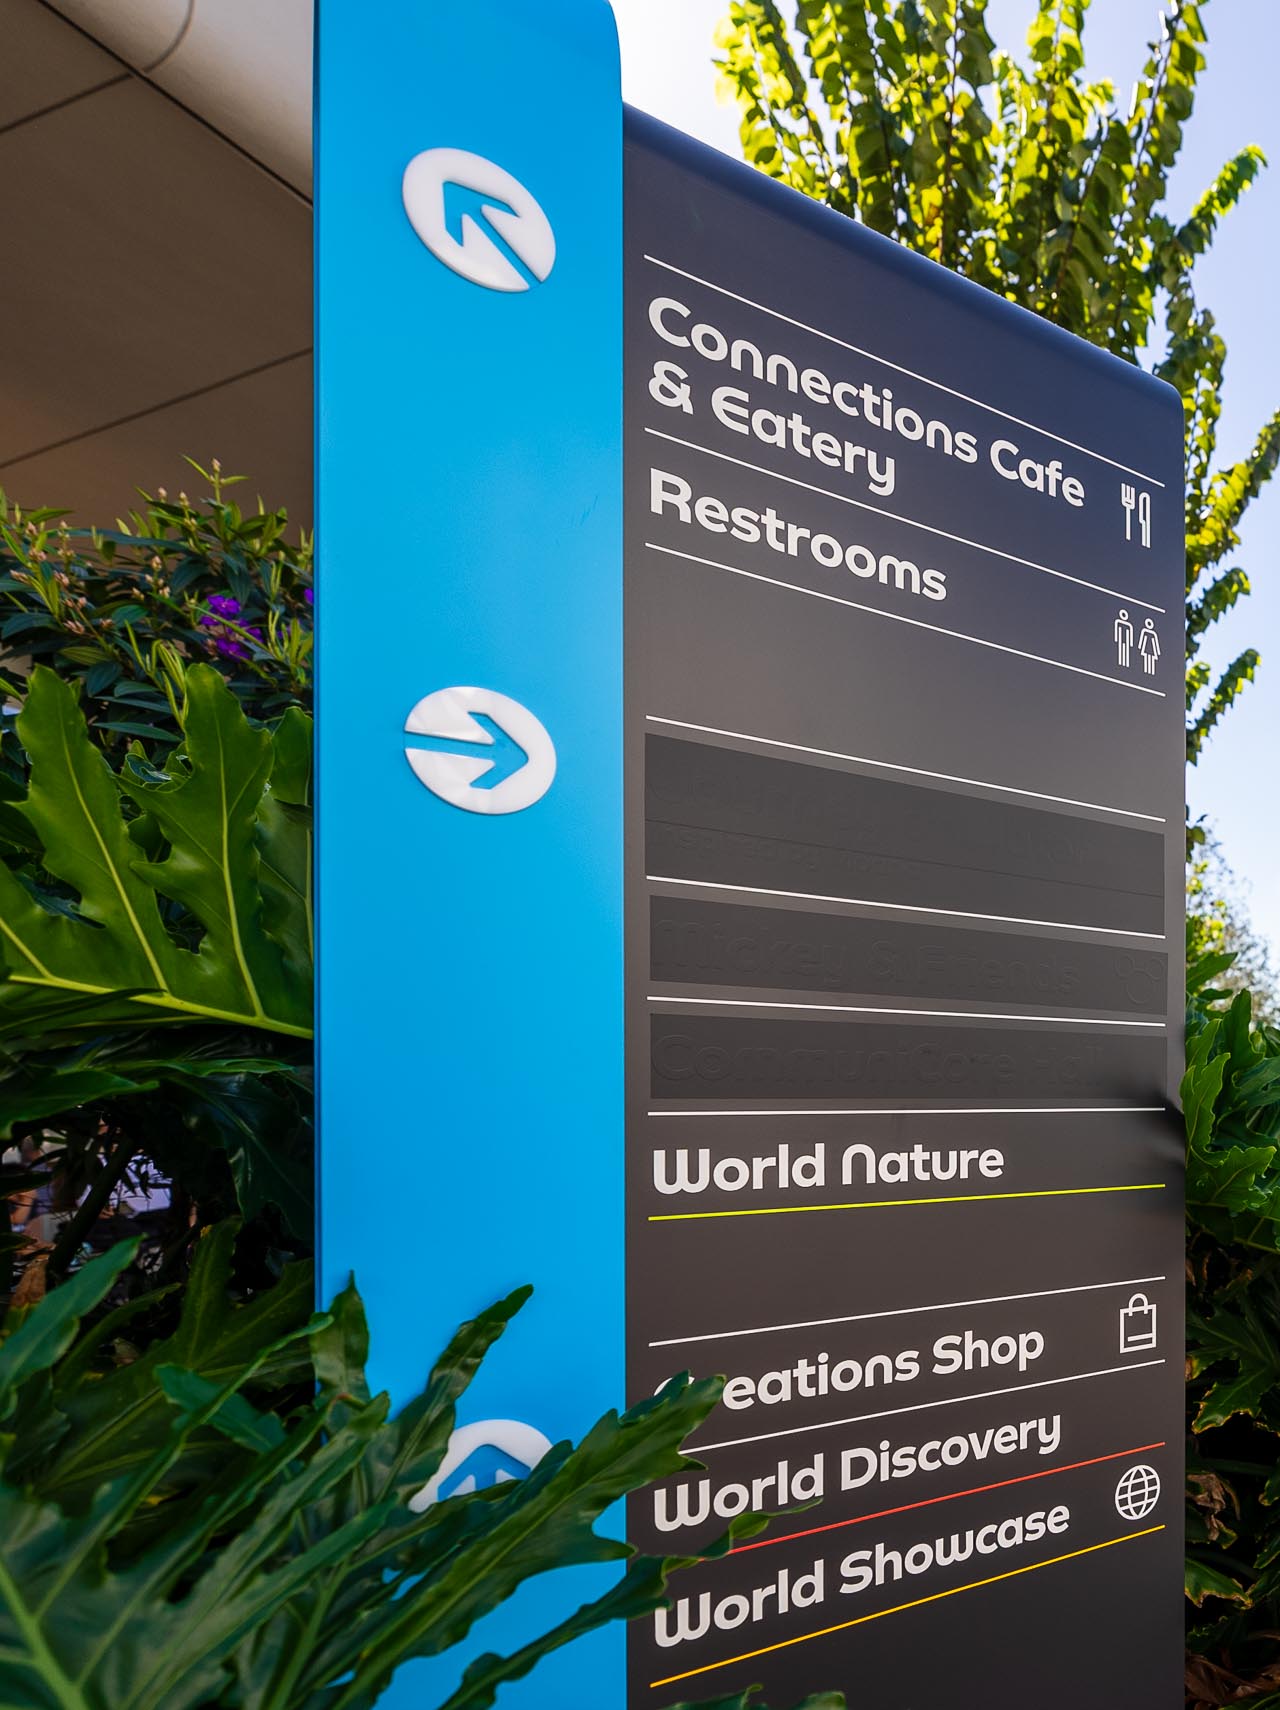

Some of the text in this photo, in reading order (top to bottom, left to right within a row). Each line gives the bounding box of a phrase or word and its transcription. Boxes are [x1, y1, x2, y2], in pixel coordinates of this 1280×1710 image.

[648, 297, 1085, 507] Connections Cafe
[648, 360, 895, 497] & Eatery
[650, 467, 947, 601] Restrooms
[653, 1142, 1005, 1195] World Nature
[654, 1330, 1045, 1410] eations Shop
[654, 1414, 1061, 1532] World Discovery
[654, 1505, 1070, 1648] World Showcase
